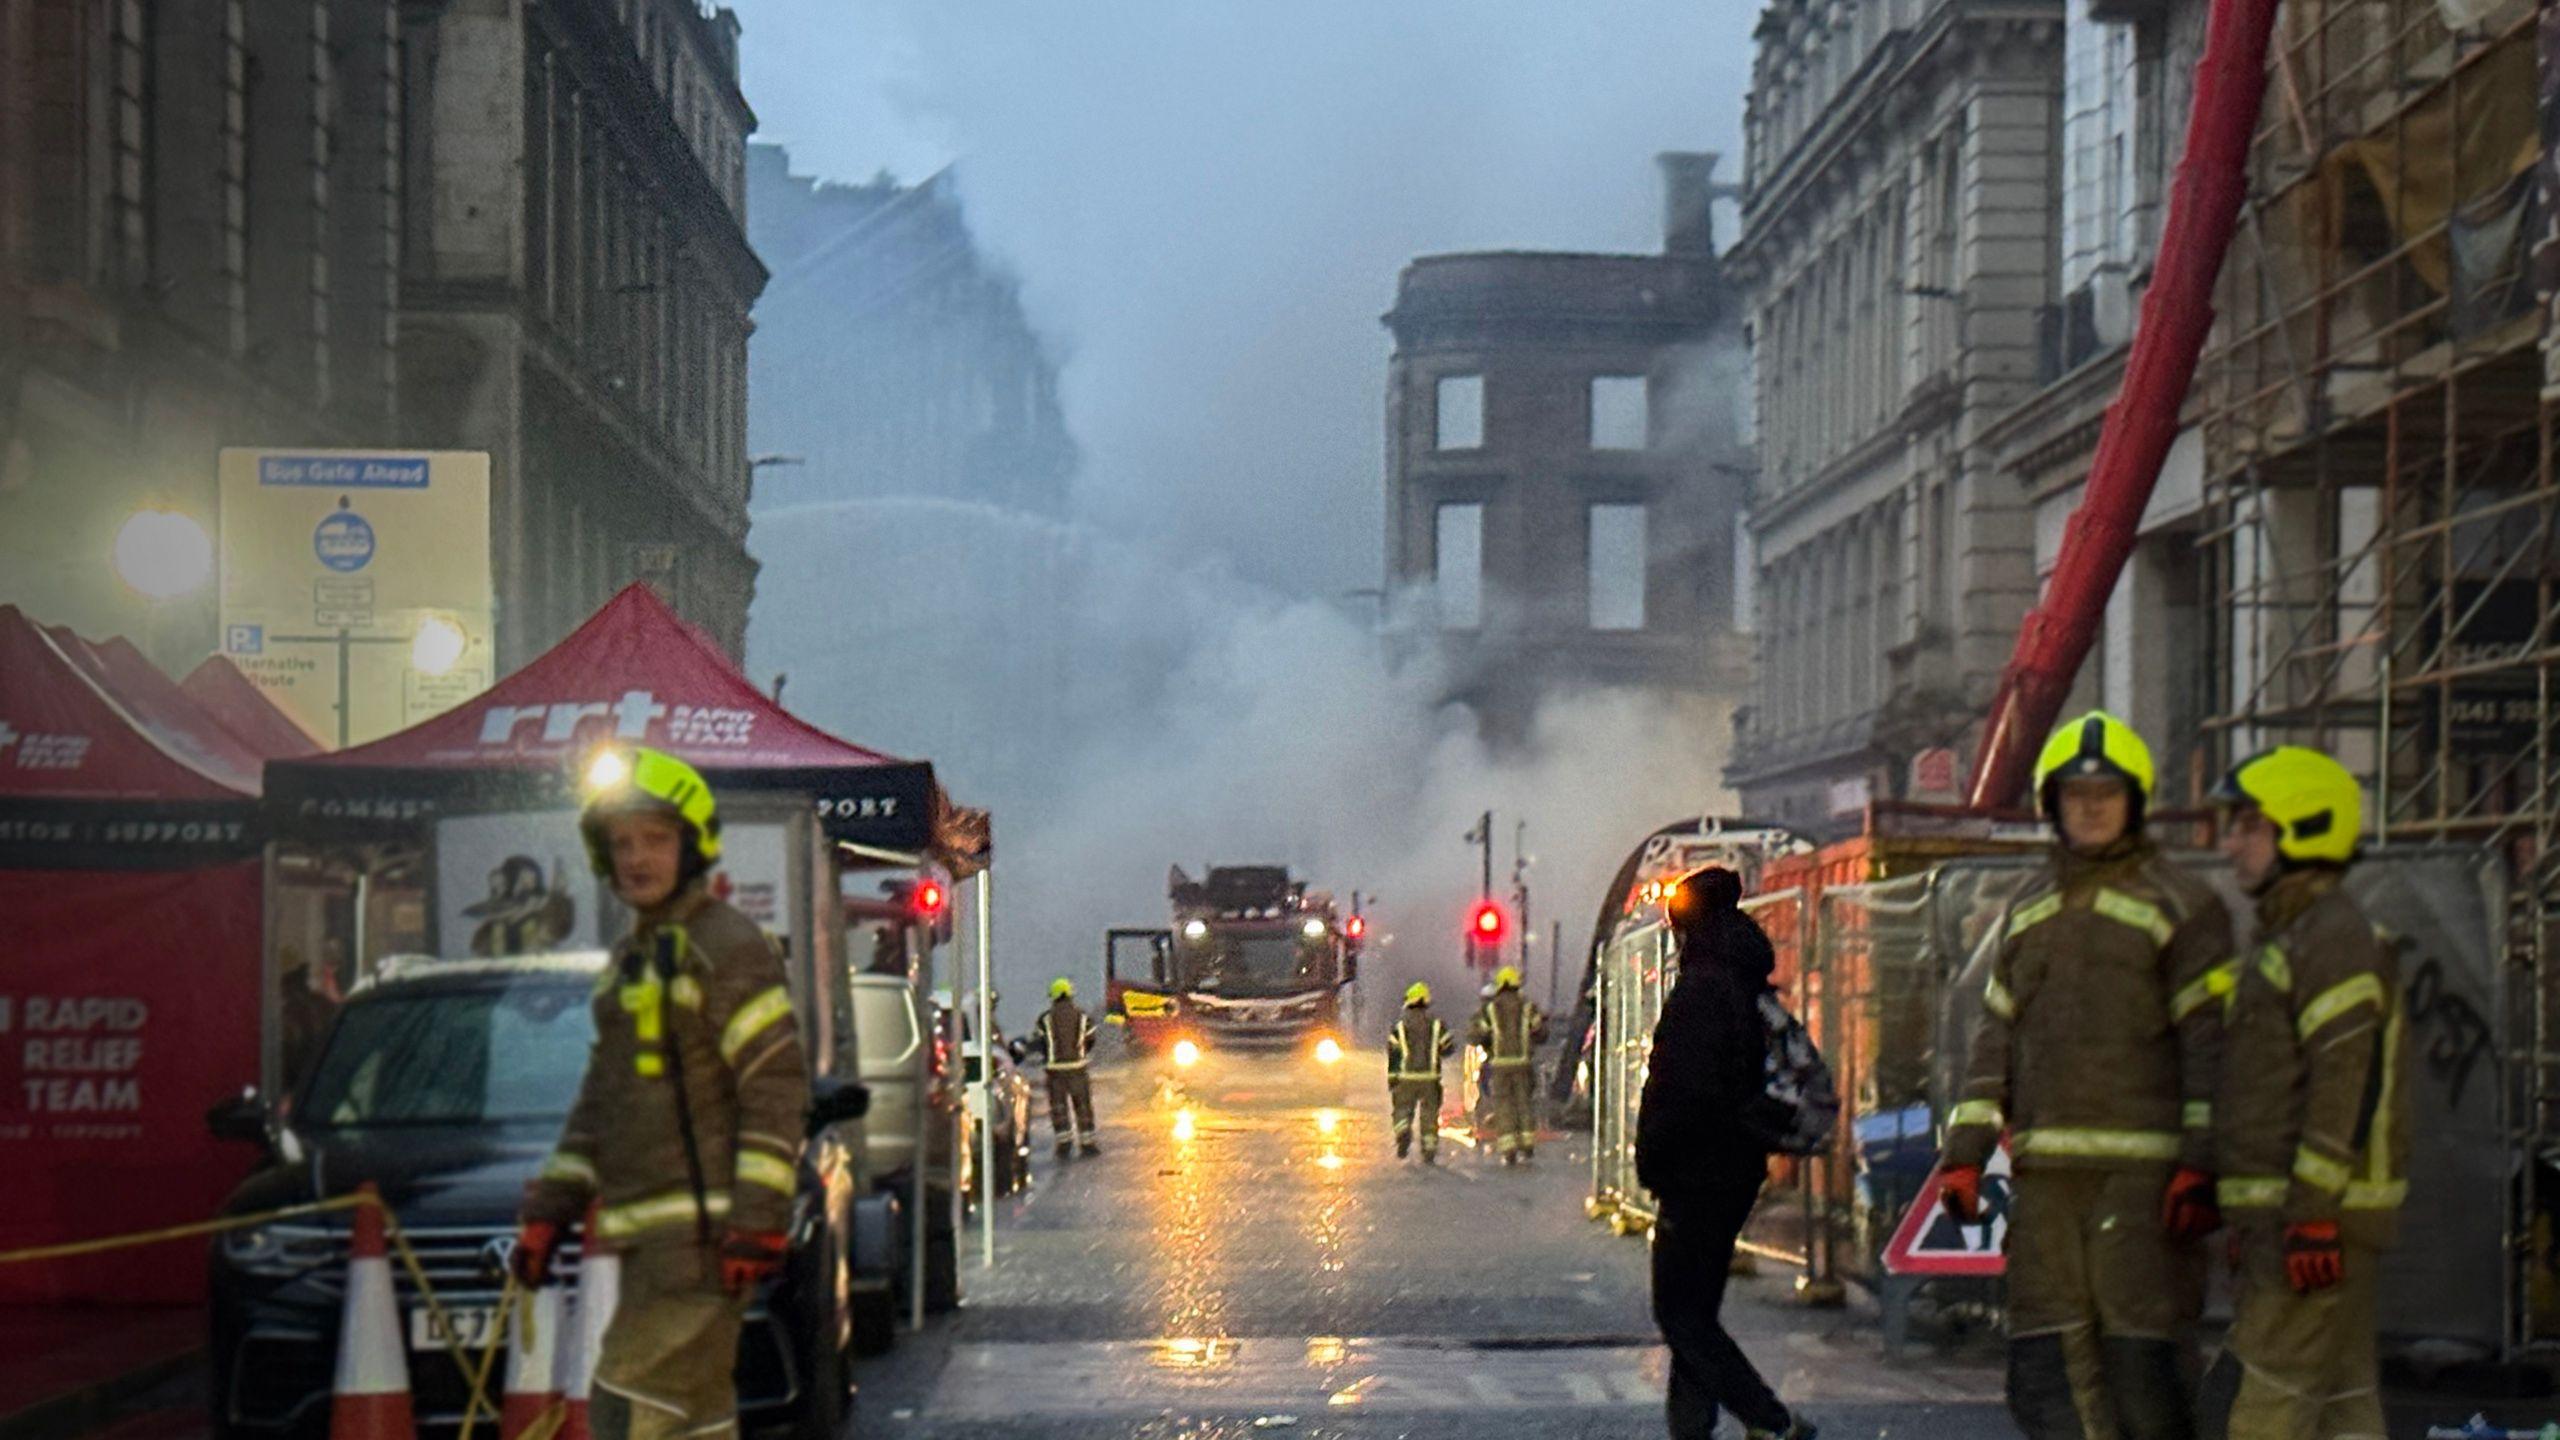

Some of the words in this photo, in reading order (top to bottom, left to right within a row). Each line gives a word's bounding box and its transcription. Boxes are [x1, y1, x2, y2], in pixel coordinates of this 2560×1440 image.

[264, 461, 303, 482] Bus
[307, 461, 356, 482] Gate
[361, 463, 425, 484] Ahead
[233, 656, 316, 671] lternative
[104, 820, 244, 842] SUPPORT
[24, 998, 148, 1032] RAPID
[23, 1037, 142, 1071] RELIEF
[22, 1078, 141, 1113] TEAM
